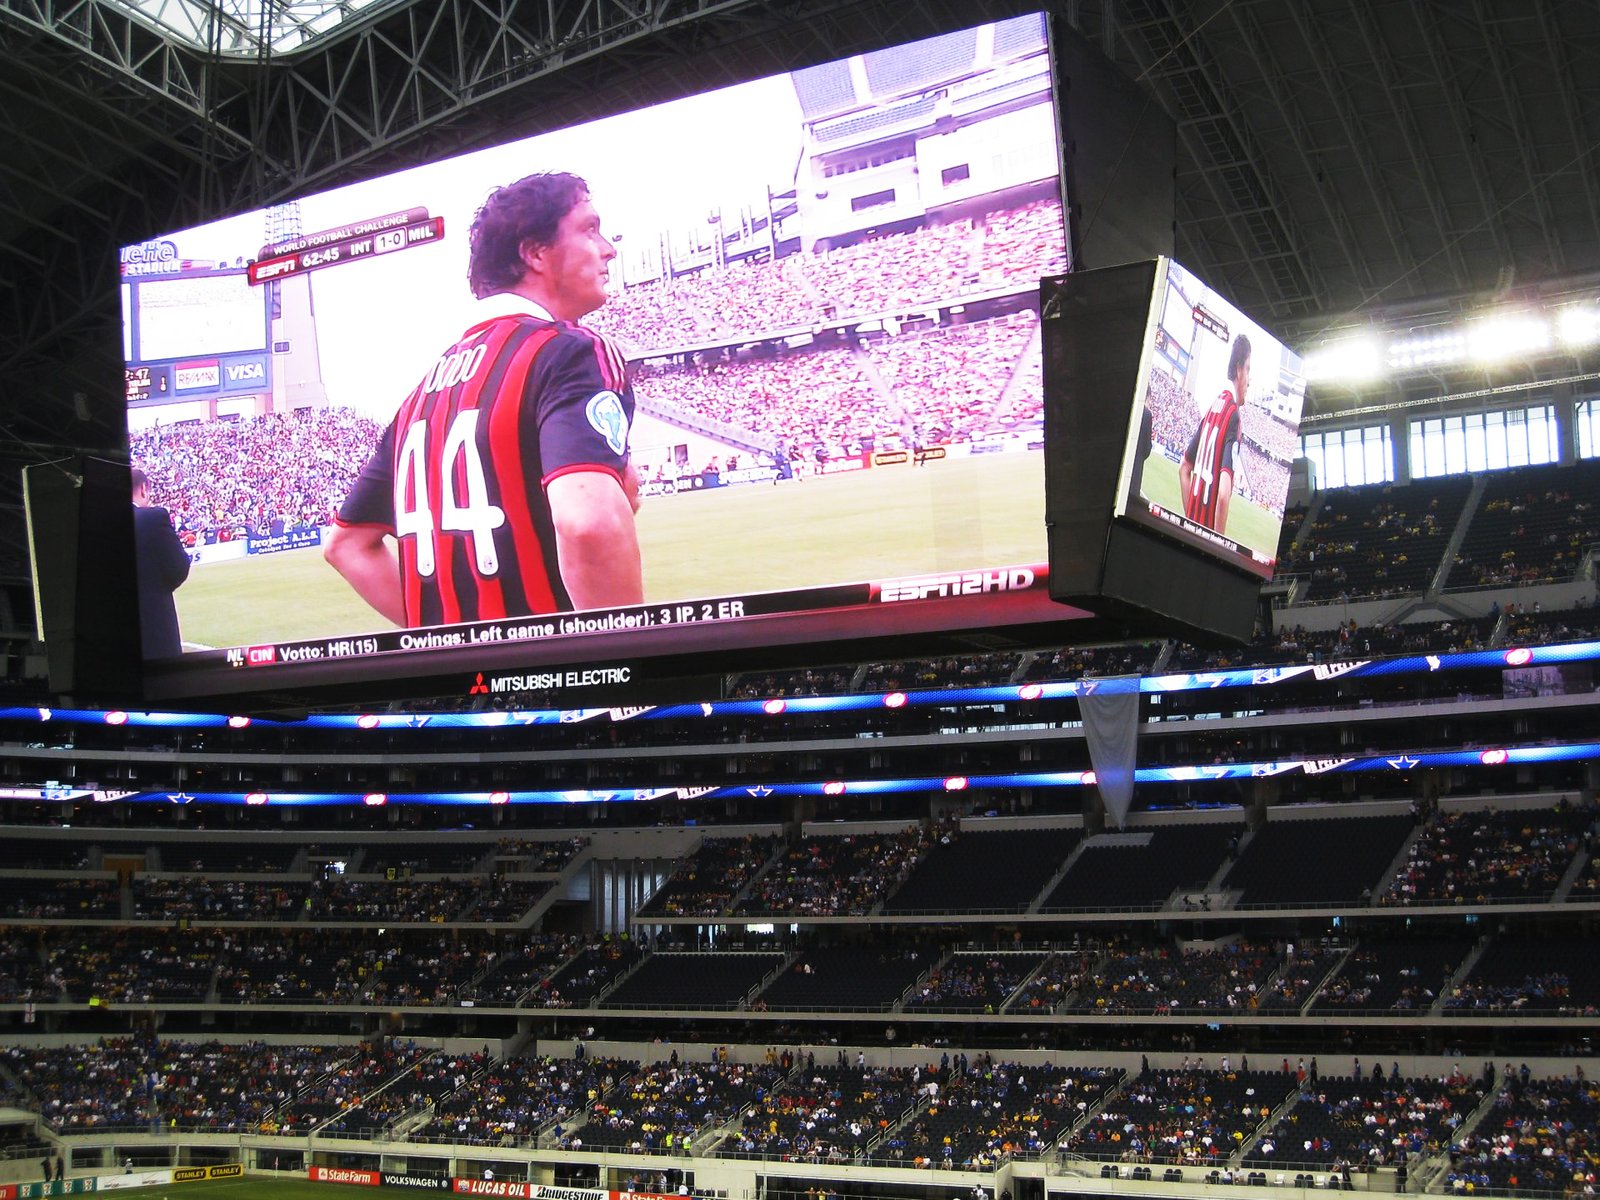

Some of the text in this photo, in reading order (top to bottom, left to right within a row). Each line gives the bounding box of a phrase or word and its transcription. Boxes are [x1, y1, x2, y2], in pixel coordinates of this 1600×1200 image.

[273, 214, 409, 255] WORLD FOOTBALL CHALLENGE
[256, 226, 434, 279] ESPN 62:45 INT 1-0 MIL
[225, 362, 264, 381] VISA
[395, 408, 506, 577] 44
[250, 534, 289, 549] Project
[470, 625, 503, 643] Left
[507, 622, 555, 640] game
[660, 608, 671, 624] 3
[701, 604, 713, 620] 2
[718, 600, 745, 619] ER
[226, 649, 244, 662] NL
[250, 649, 273, 663] CIN
[328, 638, 378, 657] HR(15)
[490, 667, 631, 693] MITSUBISHI ELECTRIC
[176, 1171, 205, 1180] STANLEY
[212, 1166, 240, 1177] STANLEY
[384, 1175, 438, 1188] VOLKSWAGEN
[472, 1180, 526, 1197] LUCAS OIL
